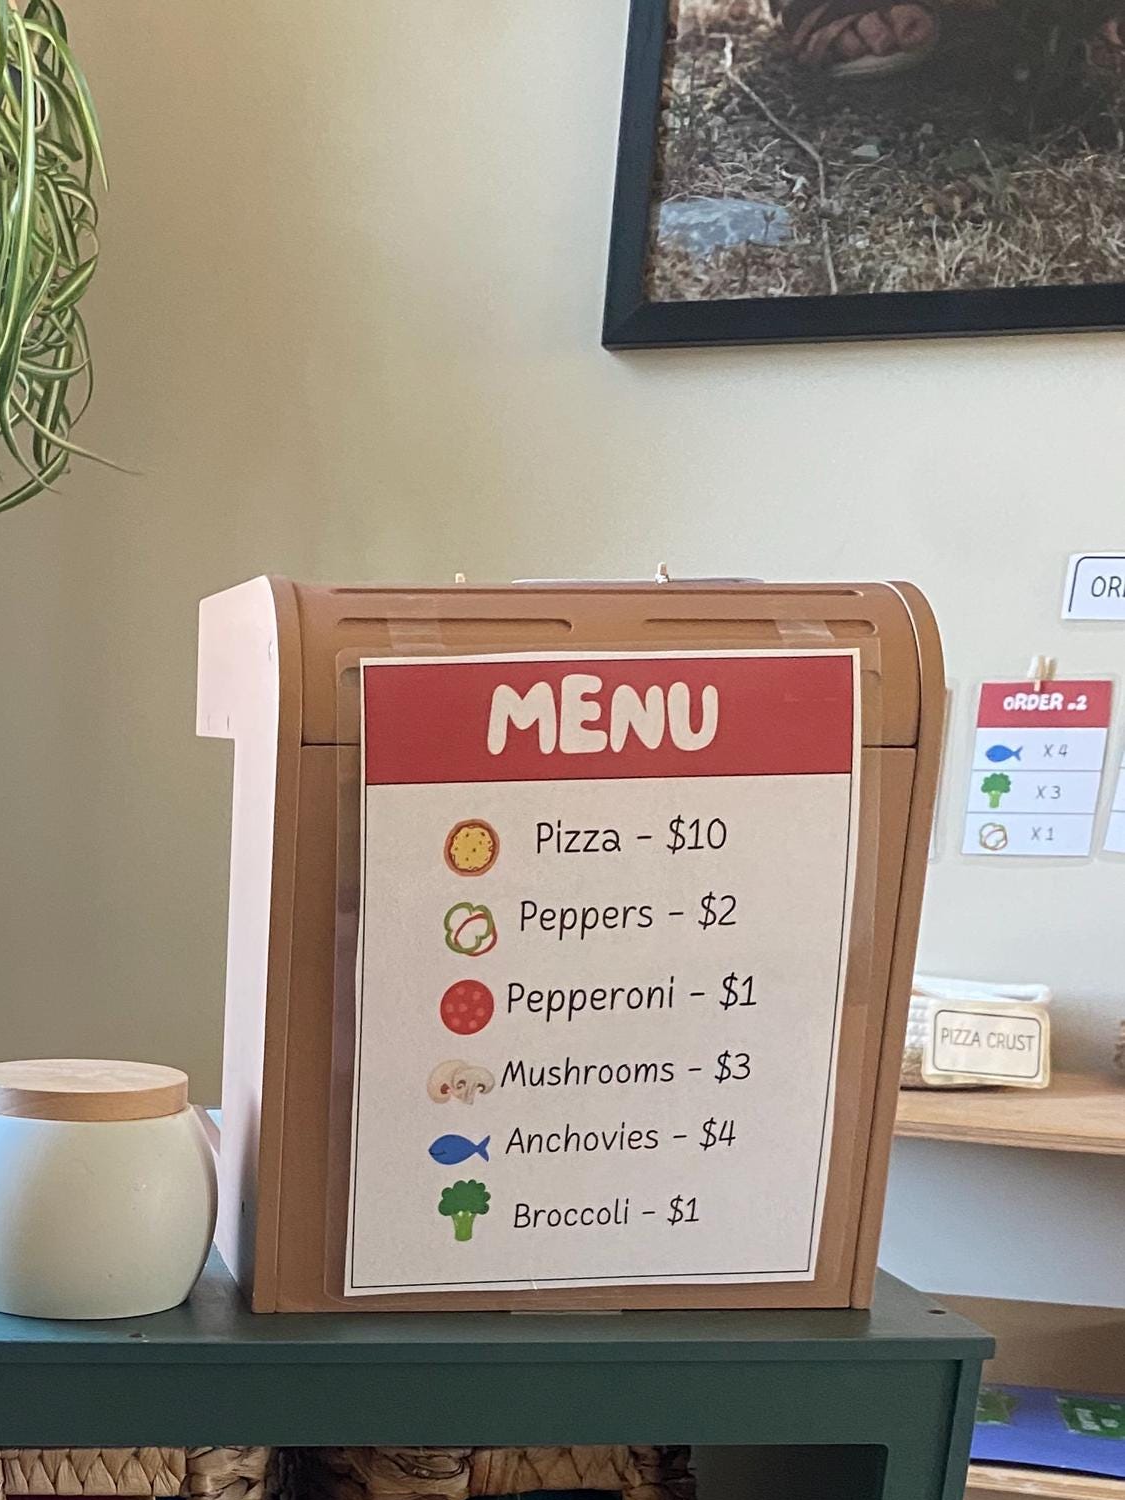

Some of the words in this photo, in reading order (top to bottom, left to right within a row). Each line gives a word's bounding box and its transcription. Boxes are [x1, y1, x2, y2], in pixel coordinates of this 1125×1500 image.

[1092, 576, 1125, 597] OR
[487, 673, 719, 755] MENU
[1050, 785, 1062, 800] 3
[537, 820, 621, 854] Pizza
[666, 815, 727, 855] $10
[520, 900, 653, 940] Peppers
[698, 892, 737, 931] $2
[507, 975, 675, 1023] Pepperoni
[719, 972, 757, 1011] $1
[941, 1027, 981, 1048] PIZZA
[987, 1031, 1036, 1052] CRUST
[500, 1056, 674, 1088] Mushrooms
[714, 1050, 751, 1084] $3
[505, 1121, 659, 1155] Anchovies
[699, 1116, 736, 1151] $4
[513, 1198, 629, 1229] Broccoli
[667, 1194, 700, 1226] $1
